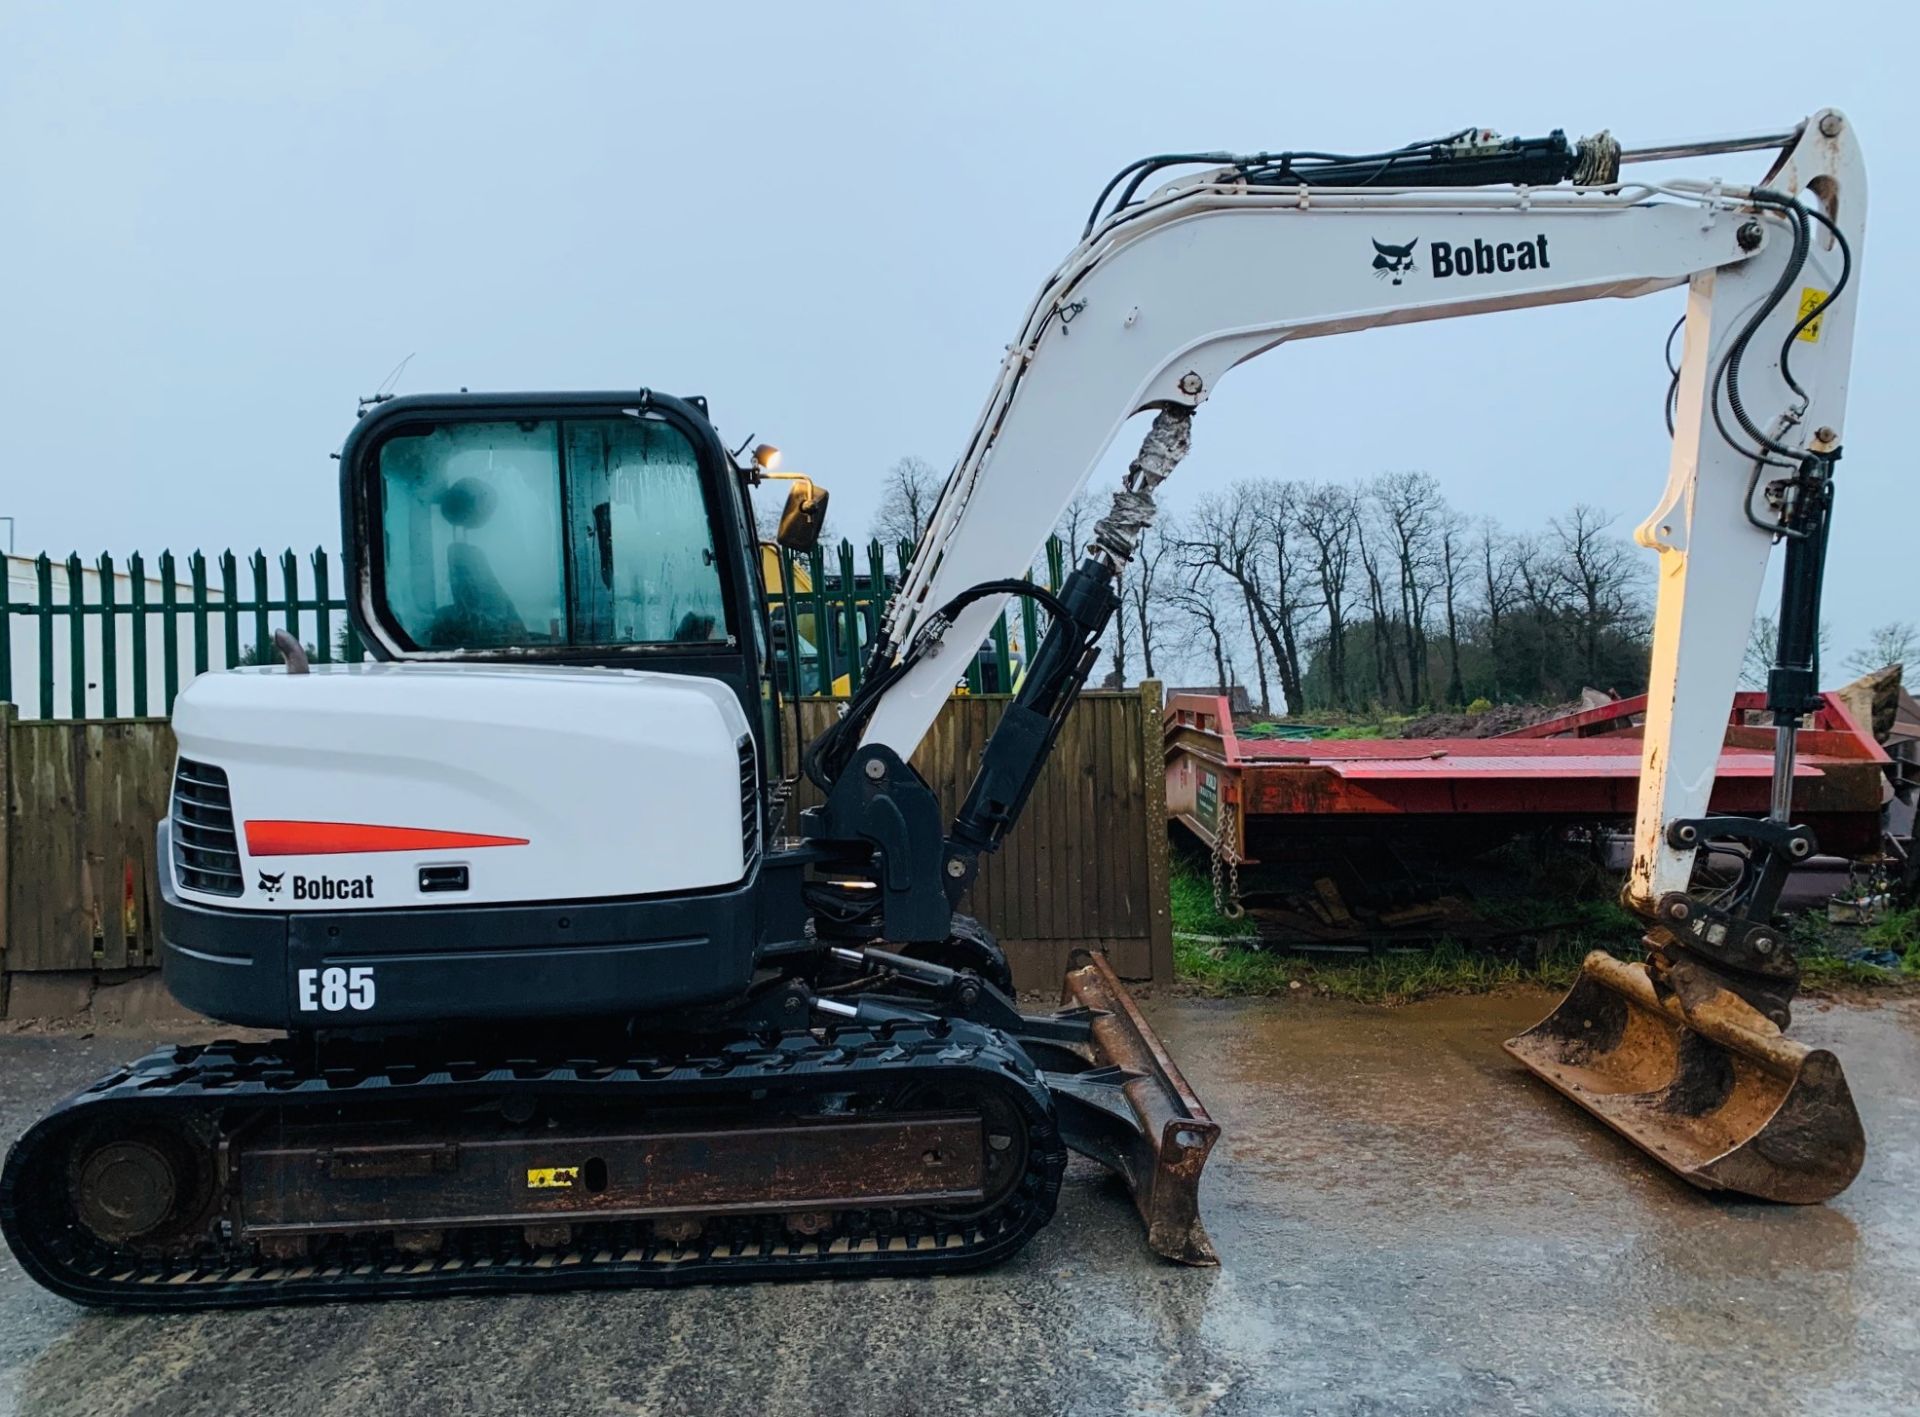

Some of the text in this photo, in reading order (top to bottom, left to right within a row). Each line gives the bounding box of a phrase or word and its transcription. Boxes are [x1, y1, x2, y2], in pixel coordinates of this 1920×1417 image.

[1431, 233, 1550, 278] Bobcat
[293, 875, 374, 900] Bobcat
[298, 967, 376, 1012] E85
